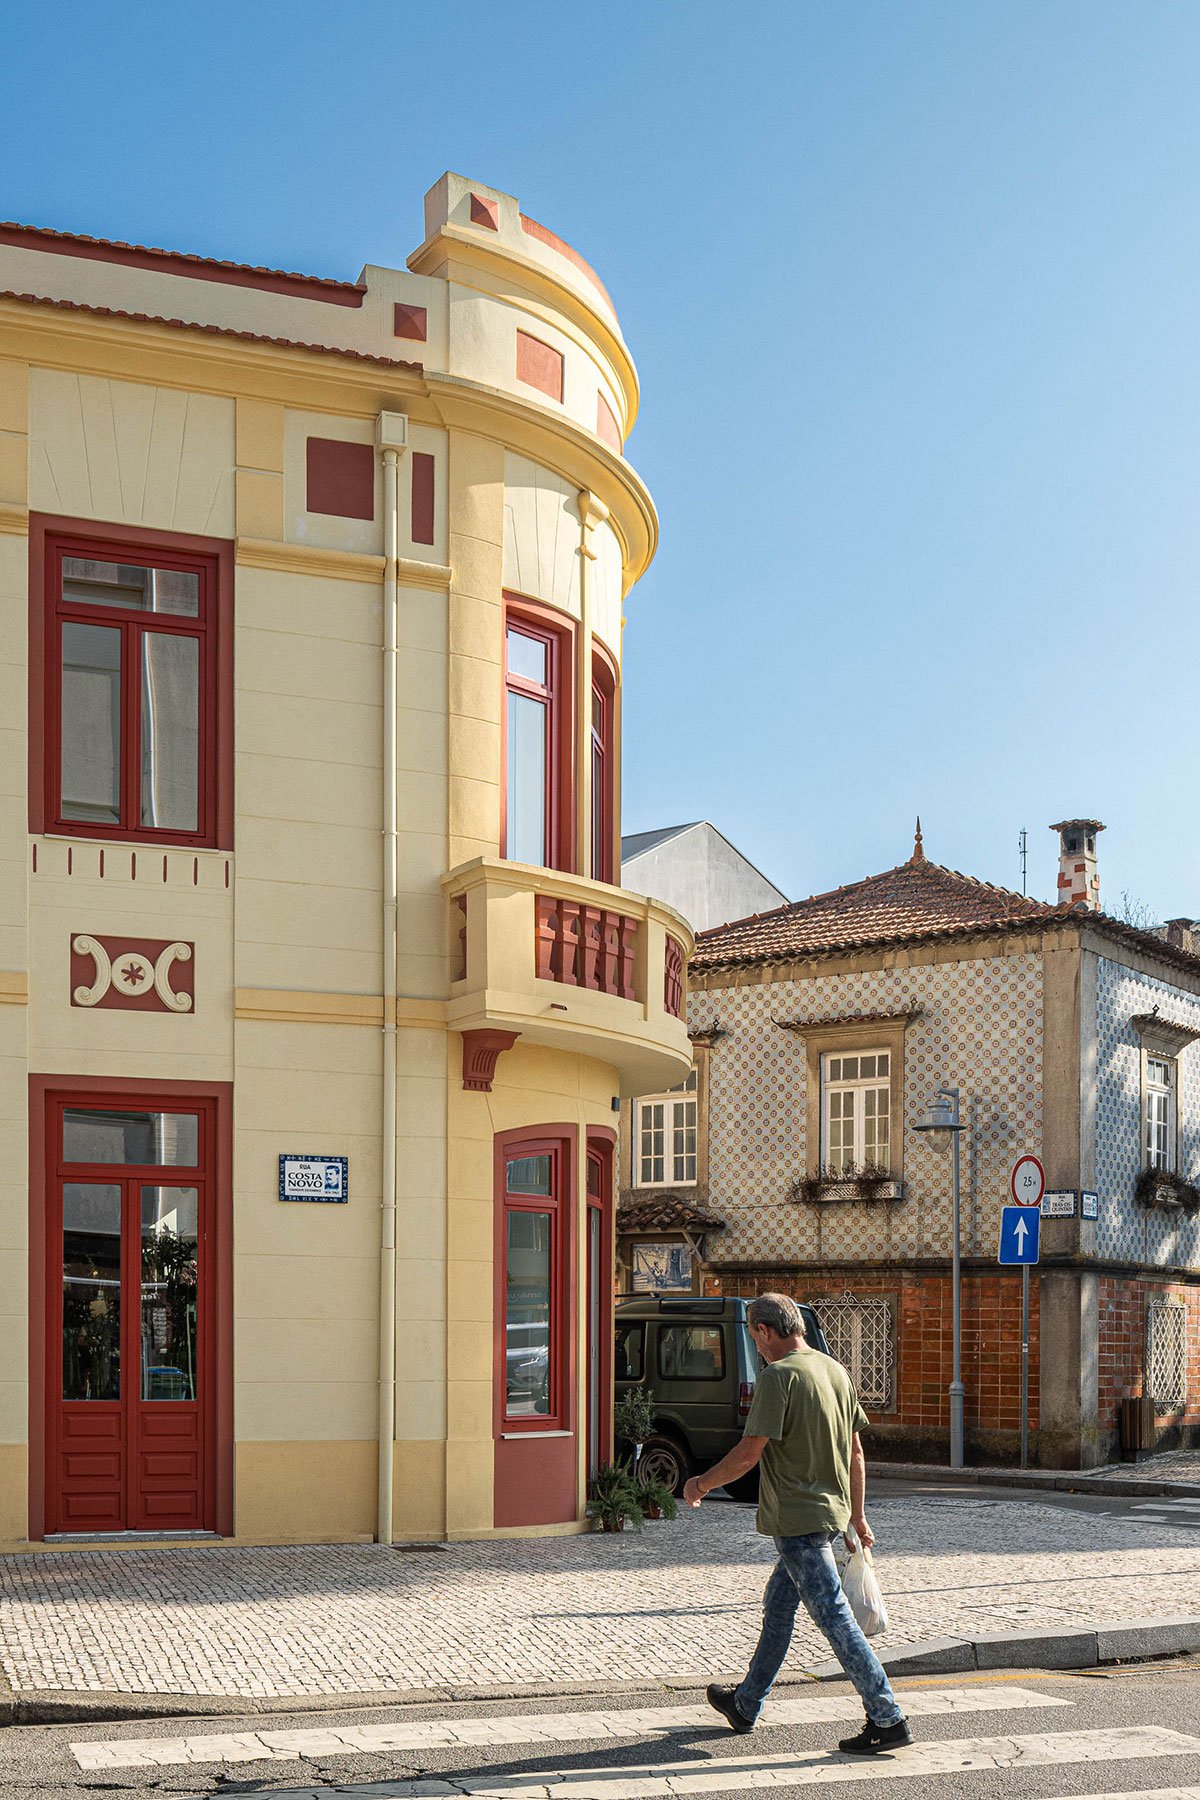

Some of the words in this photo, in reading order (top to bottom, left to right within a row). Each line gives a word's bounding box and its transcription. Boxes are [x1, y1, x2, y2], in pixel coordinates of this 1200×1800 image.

[288, 1172, 322, 1180] COSTA
[288, 1180, 322, 1188] NOVO
[1023, 1176, 1032, 1188] 2,5
